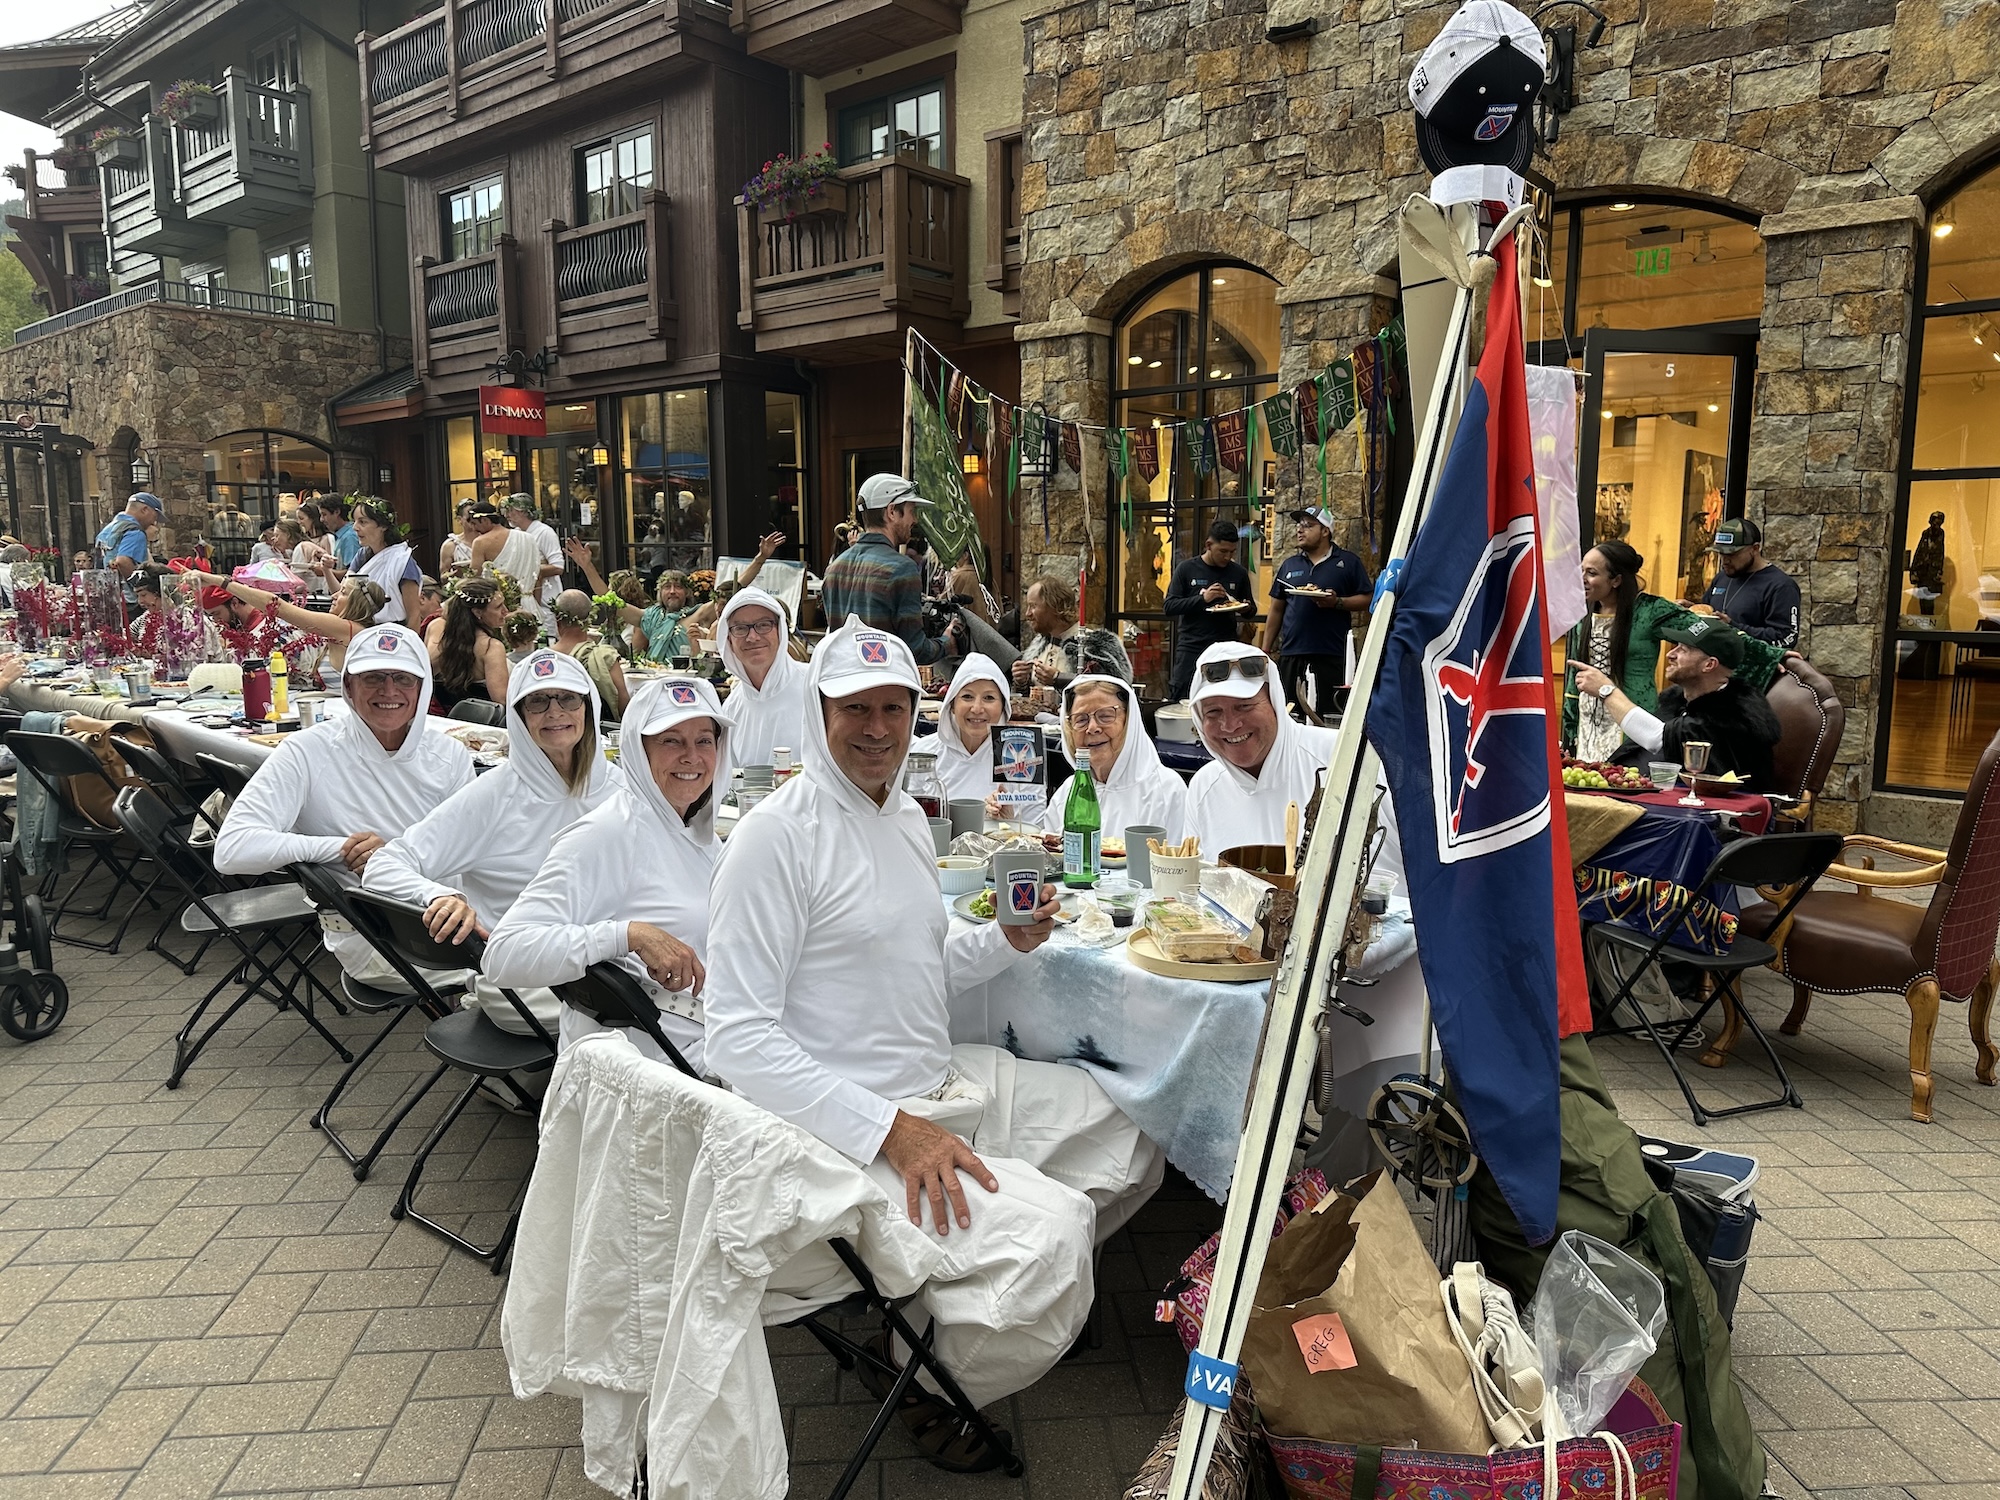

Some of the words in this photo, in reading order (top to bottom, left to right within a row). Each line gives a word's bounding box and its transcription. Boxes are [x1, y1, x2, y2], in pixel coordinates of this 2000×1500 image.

[1665, 363, 1675, 378] 5
[1329, 389, 1345, 405] SB
[1278, 422, 1292, 434] SB
[1225, 435, 1241, 449] MS
[1140, 449, 1152, 461] MS
[1004, 730, 1032, 738] MOUNTAIN
[1308, 1327, 1335, 1365] GREG
